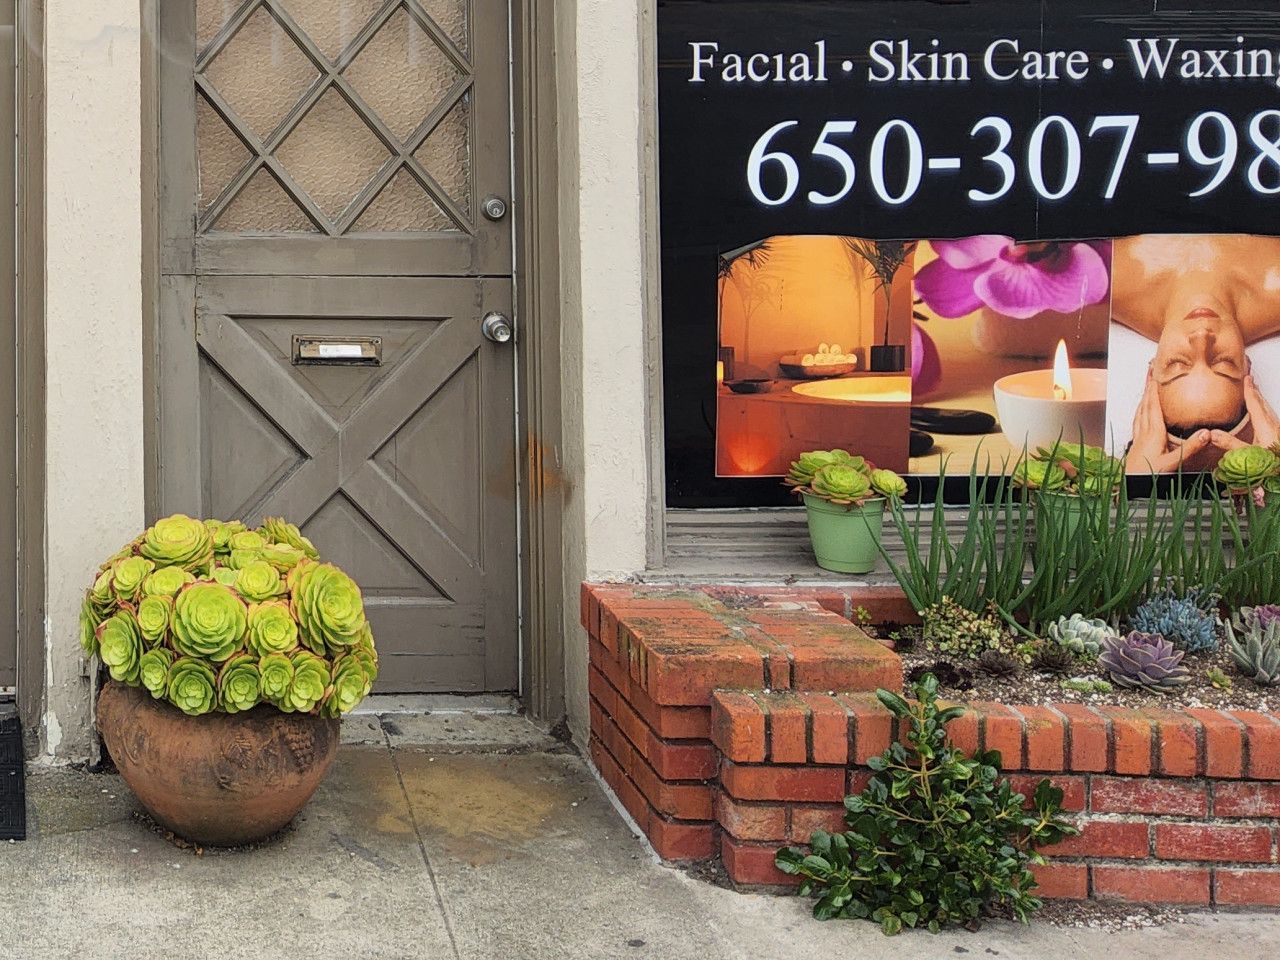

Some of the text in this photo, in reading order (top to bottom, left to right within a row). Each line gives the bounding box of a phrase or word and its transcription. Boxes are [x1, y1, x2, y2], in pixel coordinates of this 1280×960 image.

[688, 36, 1280, 89] Facial Skin Care Waxin
